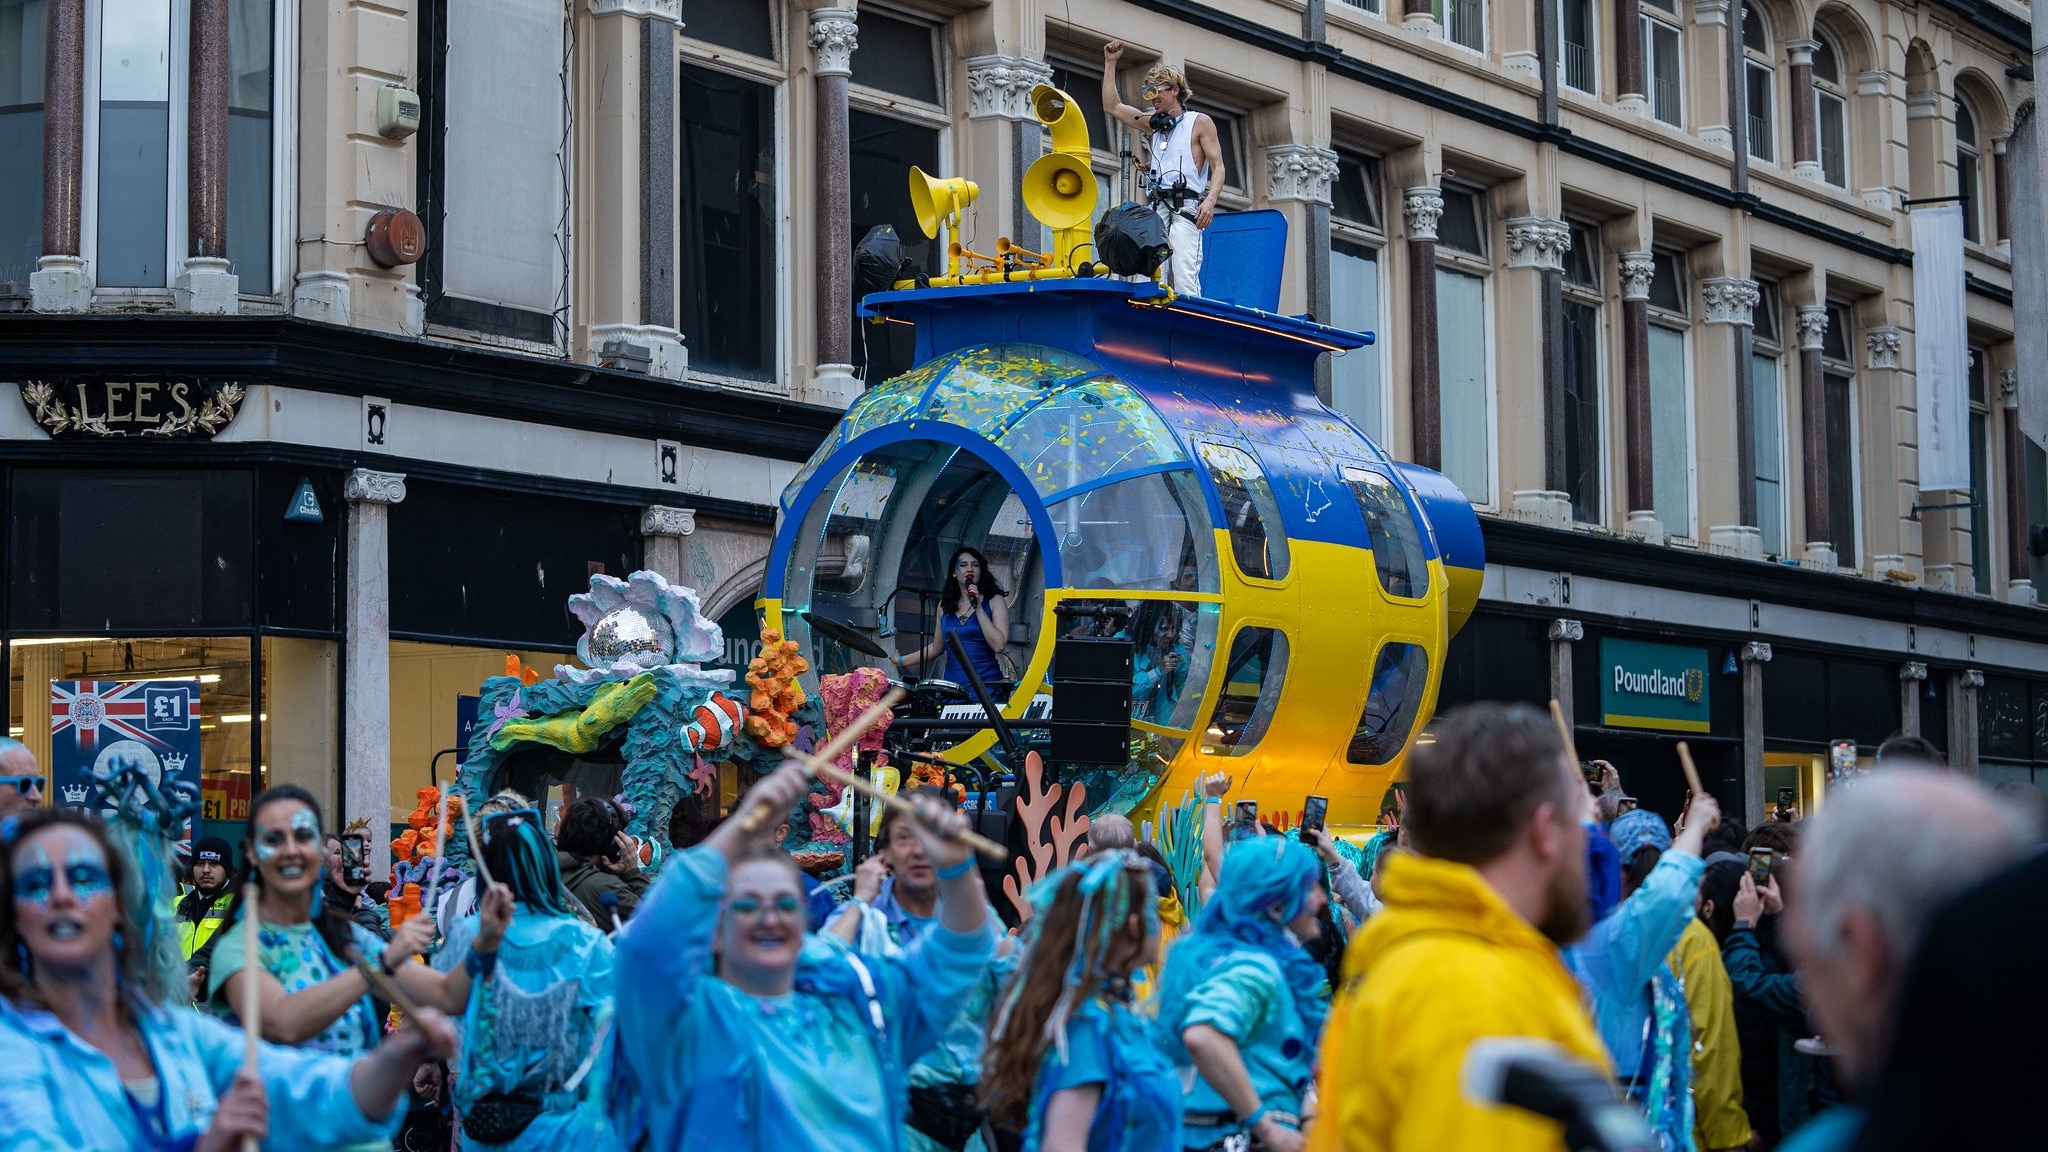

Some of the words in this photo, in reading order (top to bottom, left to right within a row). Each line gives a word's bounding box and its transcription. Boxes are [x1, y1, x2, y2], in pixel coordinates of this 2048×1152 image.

[77, 382, 190, 424] LEE'S
[300, 506, 320, 516] Chubb
[1614, 664, 1686, 697] Poundland
[154, 695, 181, 718] £1
[204, 799, 220, 819] £1
